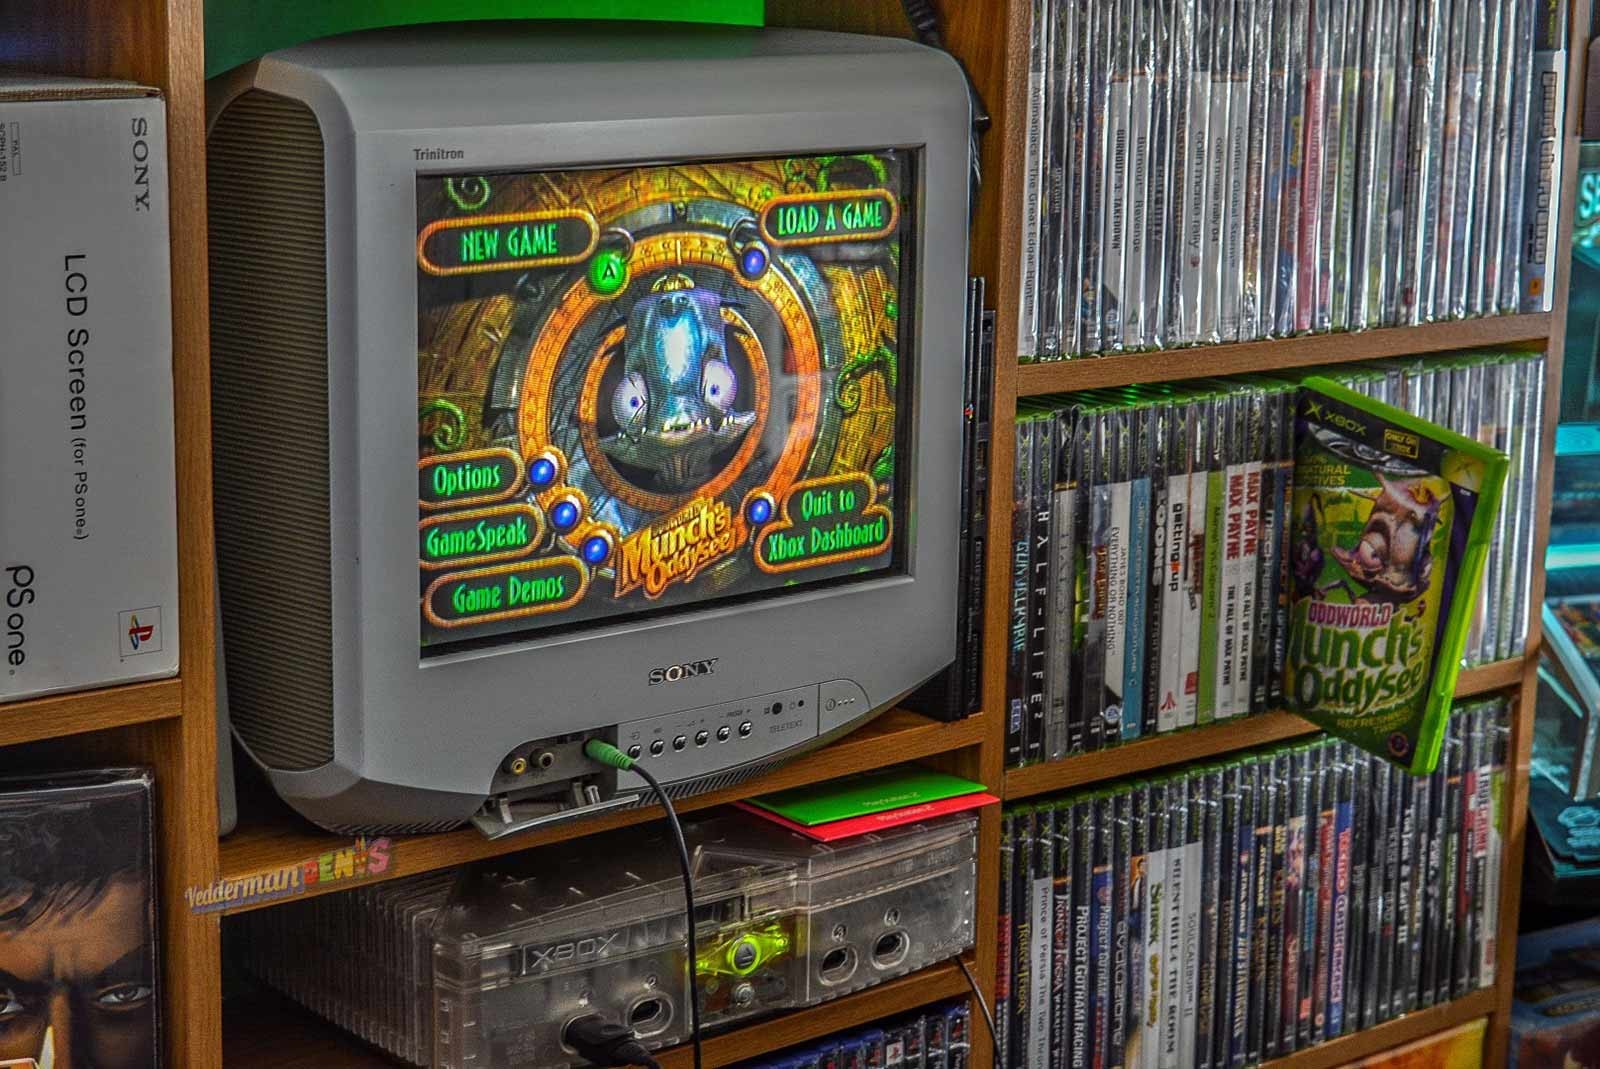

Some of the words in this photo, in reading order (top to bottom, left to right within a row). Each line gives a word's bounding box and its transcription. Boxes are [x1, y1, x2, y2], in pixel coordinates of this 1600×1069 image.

[1029, 86, 1041, 156] Animaniacs
[413, 147, 465, 161] Trinitron
[777, 206, 818, 236] LOAD
[825, 207, 838, 231] A
[842, 201, 883, 230] GAME
[1028, 193, 1038, 227] Great
[1132, 200, 1145, 253] Revenge
[461, 232, 499, 262] NEW
[506, 223, 558, 258] GAME
[1025, 231, 1036, 266] Edgar
[1187, 219, 1202, 250] rally
[64, 253, 88, 318] LCD
[66, 327, 89, 431] Screen
[1325, 410, 1367, 436] XBOX
[70, 436, 85, 468] (for
[433, 463, 500, 495] Options
[1228, 474, 1243, 509] MAX
[1245, 471, 1261, 504] MAX
[801, 490, 832, 522] Quit
[838, 489, 855, 511] to
[426, 516, 528, 557] GameSpeak
[768, 533, 806, 562] Xbox
[811, 517, 885, 548] Dashboard
[1170, 502, 1184, 562] getting
[1226, 511, 1242, 560] PAYNE
[1243, 508, 1259, 557] PAYNE
[1110, 526, 1121, 587] EVERYTHING
[452, 583, 502, 614] Game
[508, 574, 565, 606] Demos
[1109, 590, 1119, 604] OR
[1118, 579, 1127, 607] BOND
[1168, 573, 1180, 592] up
[1227, 585, 1236, 601] THE
[1225, 603, 1235, 623] FALL
[1242, 599, 1251, 618] FALL
[1307, 602, 1393, 629] ODDWORLD
[1224, 625, 1234, 636] OF
[1240, 634, 1250, 653] MAX
[1242, 621, 1250, 632] OF
[1223, 638, 1234, 659] MAX
[649, 657, 719, 686] SONY
[1221, 660, 1232, 687] PAYNE
[1238, 655, 1249, 683] PAYNE
[1296, 660, 1424, 717] Oddysee
[184, 865, 303, 909] Vedderman
[1171, 858, 1182, 912] SILENT
[1039, 886, 1051, 922] Prince
[530, 932, 619, 968] XBOX
[1039, 928, 1049, 939] of
[1075, 905, 1089, 962] PROJECT
[1170, 916, 1180, 951] HILL
[1039, 944, 1050, 980] Persia
[1038, 985, 1048, 1006] The
[1074, 964, 1088, 1020] GOTHAM
[1168, 970, 1179, 998] THE
[1037, 1009, 1047, 1031] Two
[1166, 1004, 1178, 1054] ROOM
[1183, 1007, 1193, 1018] II
[1072, 1022, 1087, 1068] RACING
